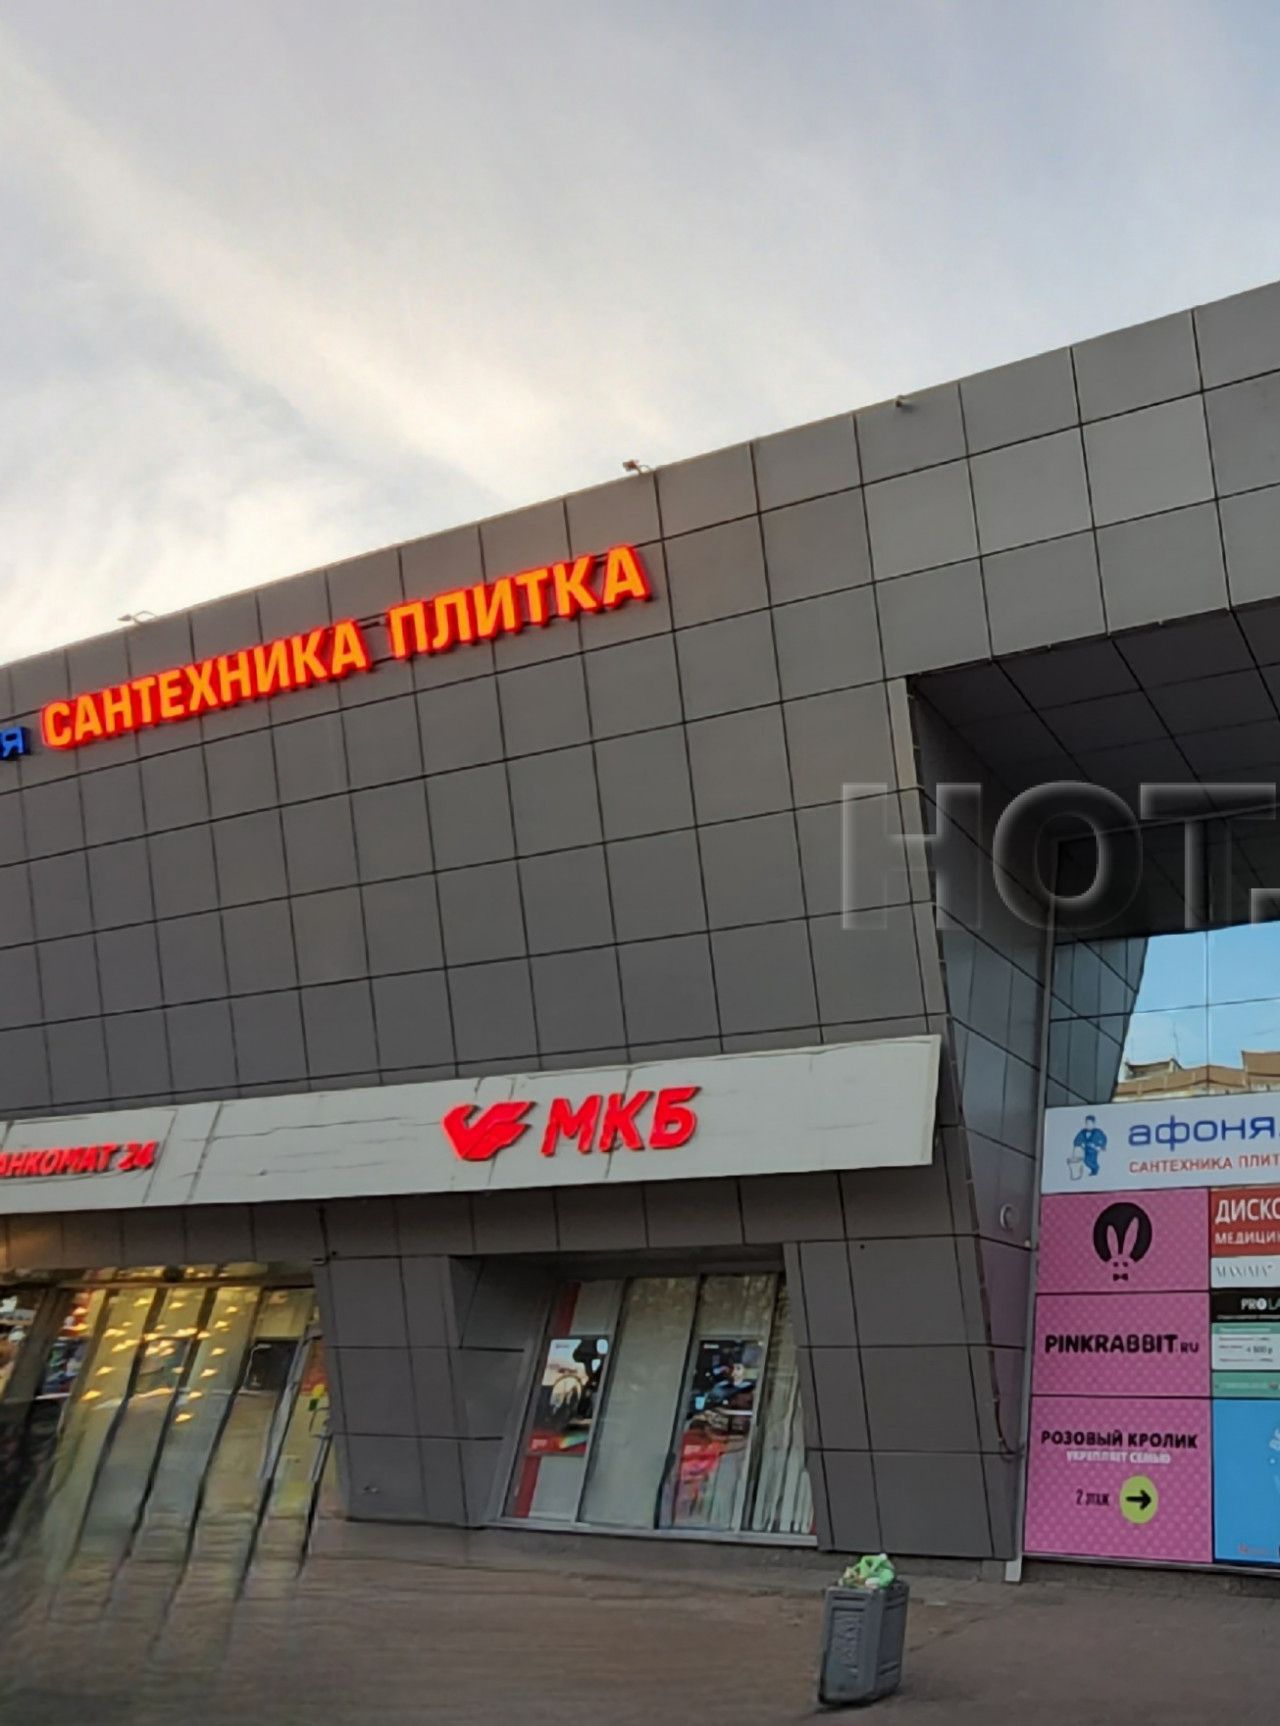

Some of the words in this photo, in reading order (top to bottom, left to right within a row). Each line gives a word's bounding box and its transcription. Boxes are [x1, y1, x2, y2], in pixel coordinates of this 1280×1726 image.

[42, 618, 371, 750] САНТЕХНИКА
[386, 544, 650, 661] ПЛИТКА
[540, 1086, 700, 1156] МКБ
[117, 1140, 157, 1171] 24
[1129, 1158, 1233, 1175] САНТЕХНИКА
[1041, 1430, 1123, 1447] РОЗОВЫЙ
[1128, 1433, 1197, 1449] КРОЛИК
